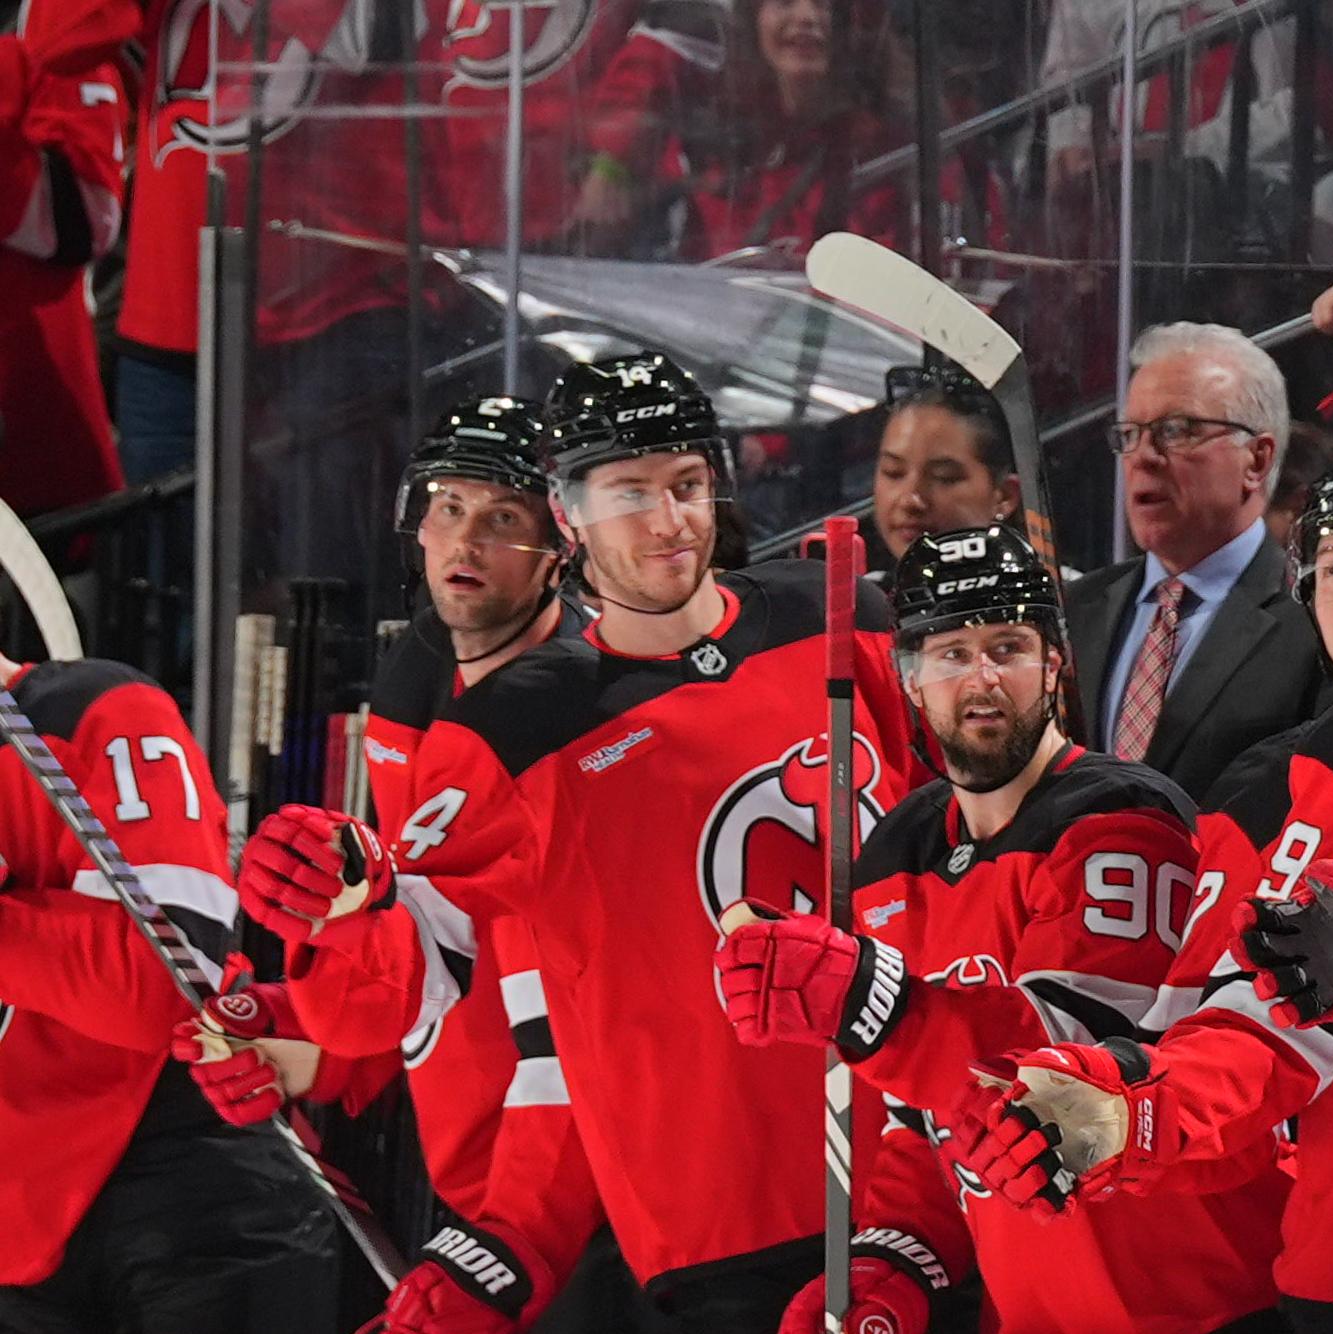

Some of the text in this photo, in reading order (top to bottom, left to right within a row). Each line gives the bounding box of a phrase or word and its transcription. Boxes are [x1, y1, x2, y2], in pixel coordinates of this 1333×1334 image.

[617, 403, 676, 423] CCM
[939, 537, 986, 563] 90
[937, 574, 999, 596] CCM
[105, 735, 200, 822] 17
[401, 786, 467, 860] 4
[1256, 821, 1321, 901] 9
[851, 937, 904, 1046] RIOR
[422, 1226, 518, 1295] RIOR
[850, 1227, 950, 1291] RIOR
